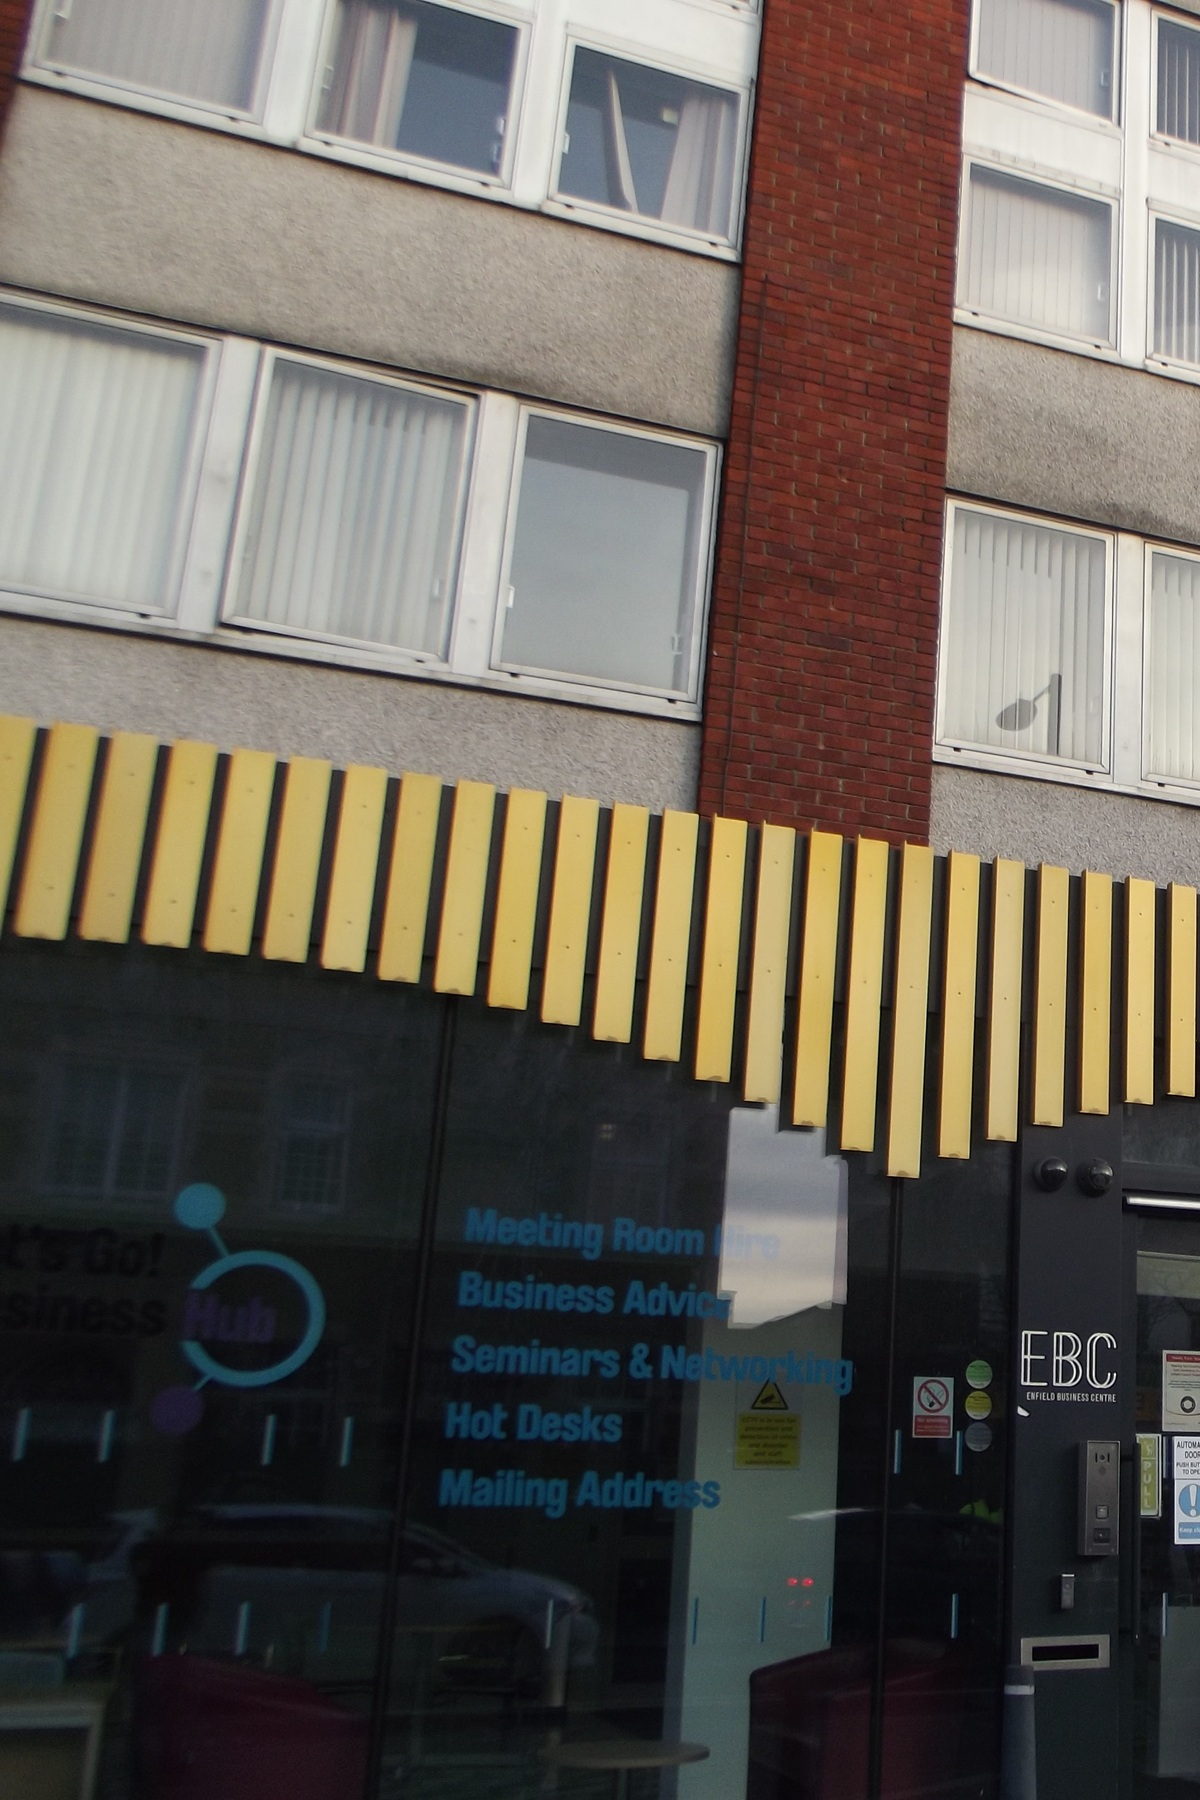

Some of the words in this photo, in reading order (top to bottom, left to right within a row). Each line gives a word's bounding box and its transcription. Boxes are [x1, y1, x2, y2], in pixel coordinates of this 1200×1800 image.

[464, 1207, 604, 1260] Meeting
[612, 1217, 705, 1256] Room
[182, 1290, 278, 1343] Hub
[457, 1270, 615, 1315] Business
[451, 1334, 620, 1379] Seminars
[629, 1342, 653, 1379] &
[660, 1345, 853, 1397] Networking
[1020, 1330, 1117, 1389] EBC
[444, 1401, 508, 1440] Hot
[516, 1404, 623, 1443] Desks
[1026, 1392, 1055, 1401] ENFIELD
[1056, 1392, 1090, 1402] BUSINESS
[1090, 1393, 1117, 1403] CENTRE
[438, 1468, 568, 1519] Mailing
[576, 1471, 721, 1509] Address
[1179, 1526, 1193, 1534] Keep
